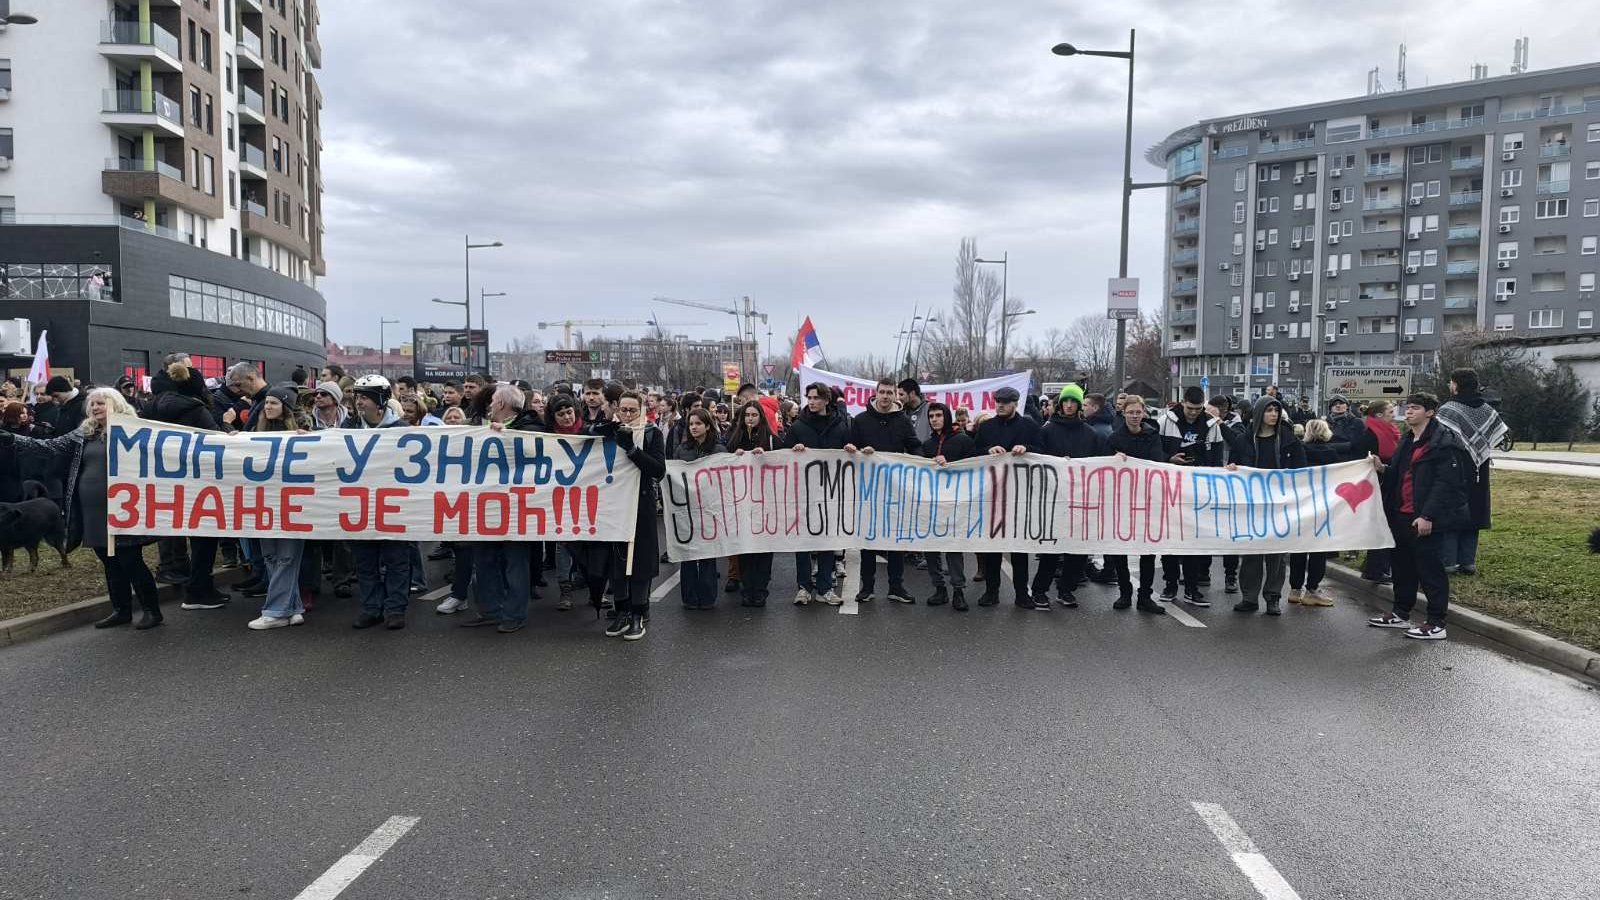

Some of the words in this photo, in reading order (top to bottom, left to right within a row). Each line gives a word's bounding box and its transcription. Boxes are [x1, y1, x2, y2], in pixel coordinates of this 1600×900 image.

[256, 307, 307, 339] SYNERGY
[1332, 369, 1370, 377] ТЕХНИЧКИ
[1374, 369, 1406, 378] ПРЕГЛЕД
[109, 425, 226, 480] МОЋ
[243, 435, 321, 483] ЈЕ
[336, 433, 381, 483] У
[394, 433, 617, 486] ЗНАЊУ!
[108, 483, 315, 532] ЗНАЊЕ
[339, 486, 410, 533] ЈЕ
[433, 485, 599, 535] МОЋ!!!
[667, 471, 694, 544] У
[694, 461, 800, 541] СТРУЈИ
[804, 458, 856, 536] СМО
[857, 459, 985, 543] МЛАДОСТИ
[989, 463, 1008, 539] И
[1013, 462, 1059, 545] ПОД
[1068, 465, 1184, 543] НАПОНОМ
[1192, 465, 1331, 542] РАДОСТИ
